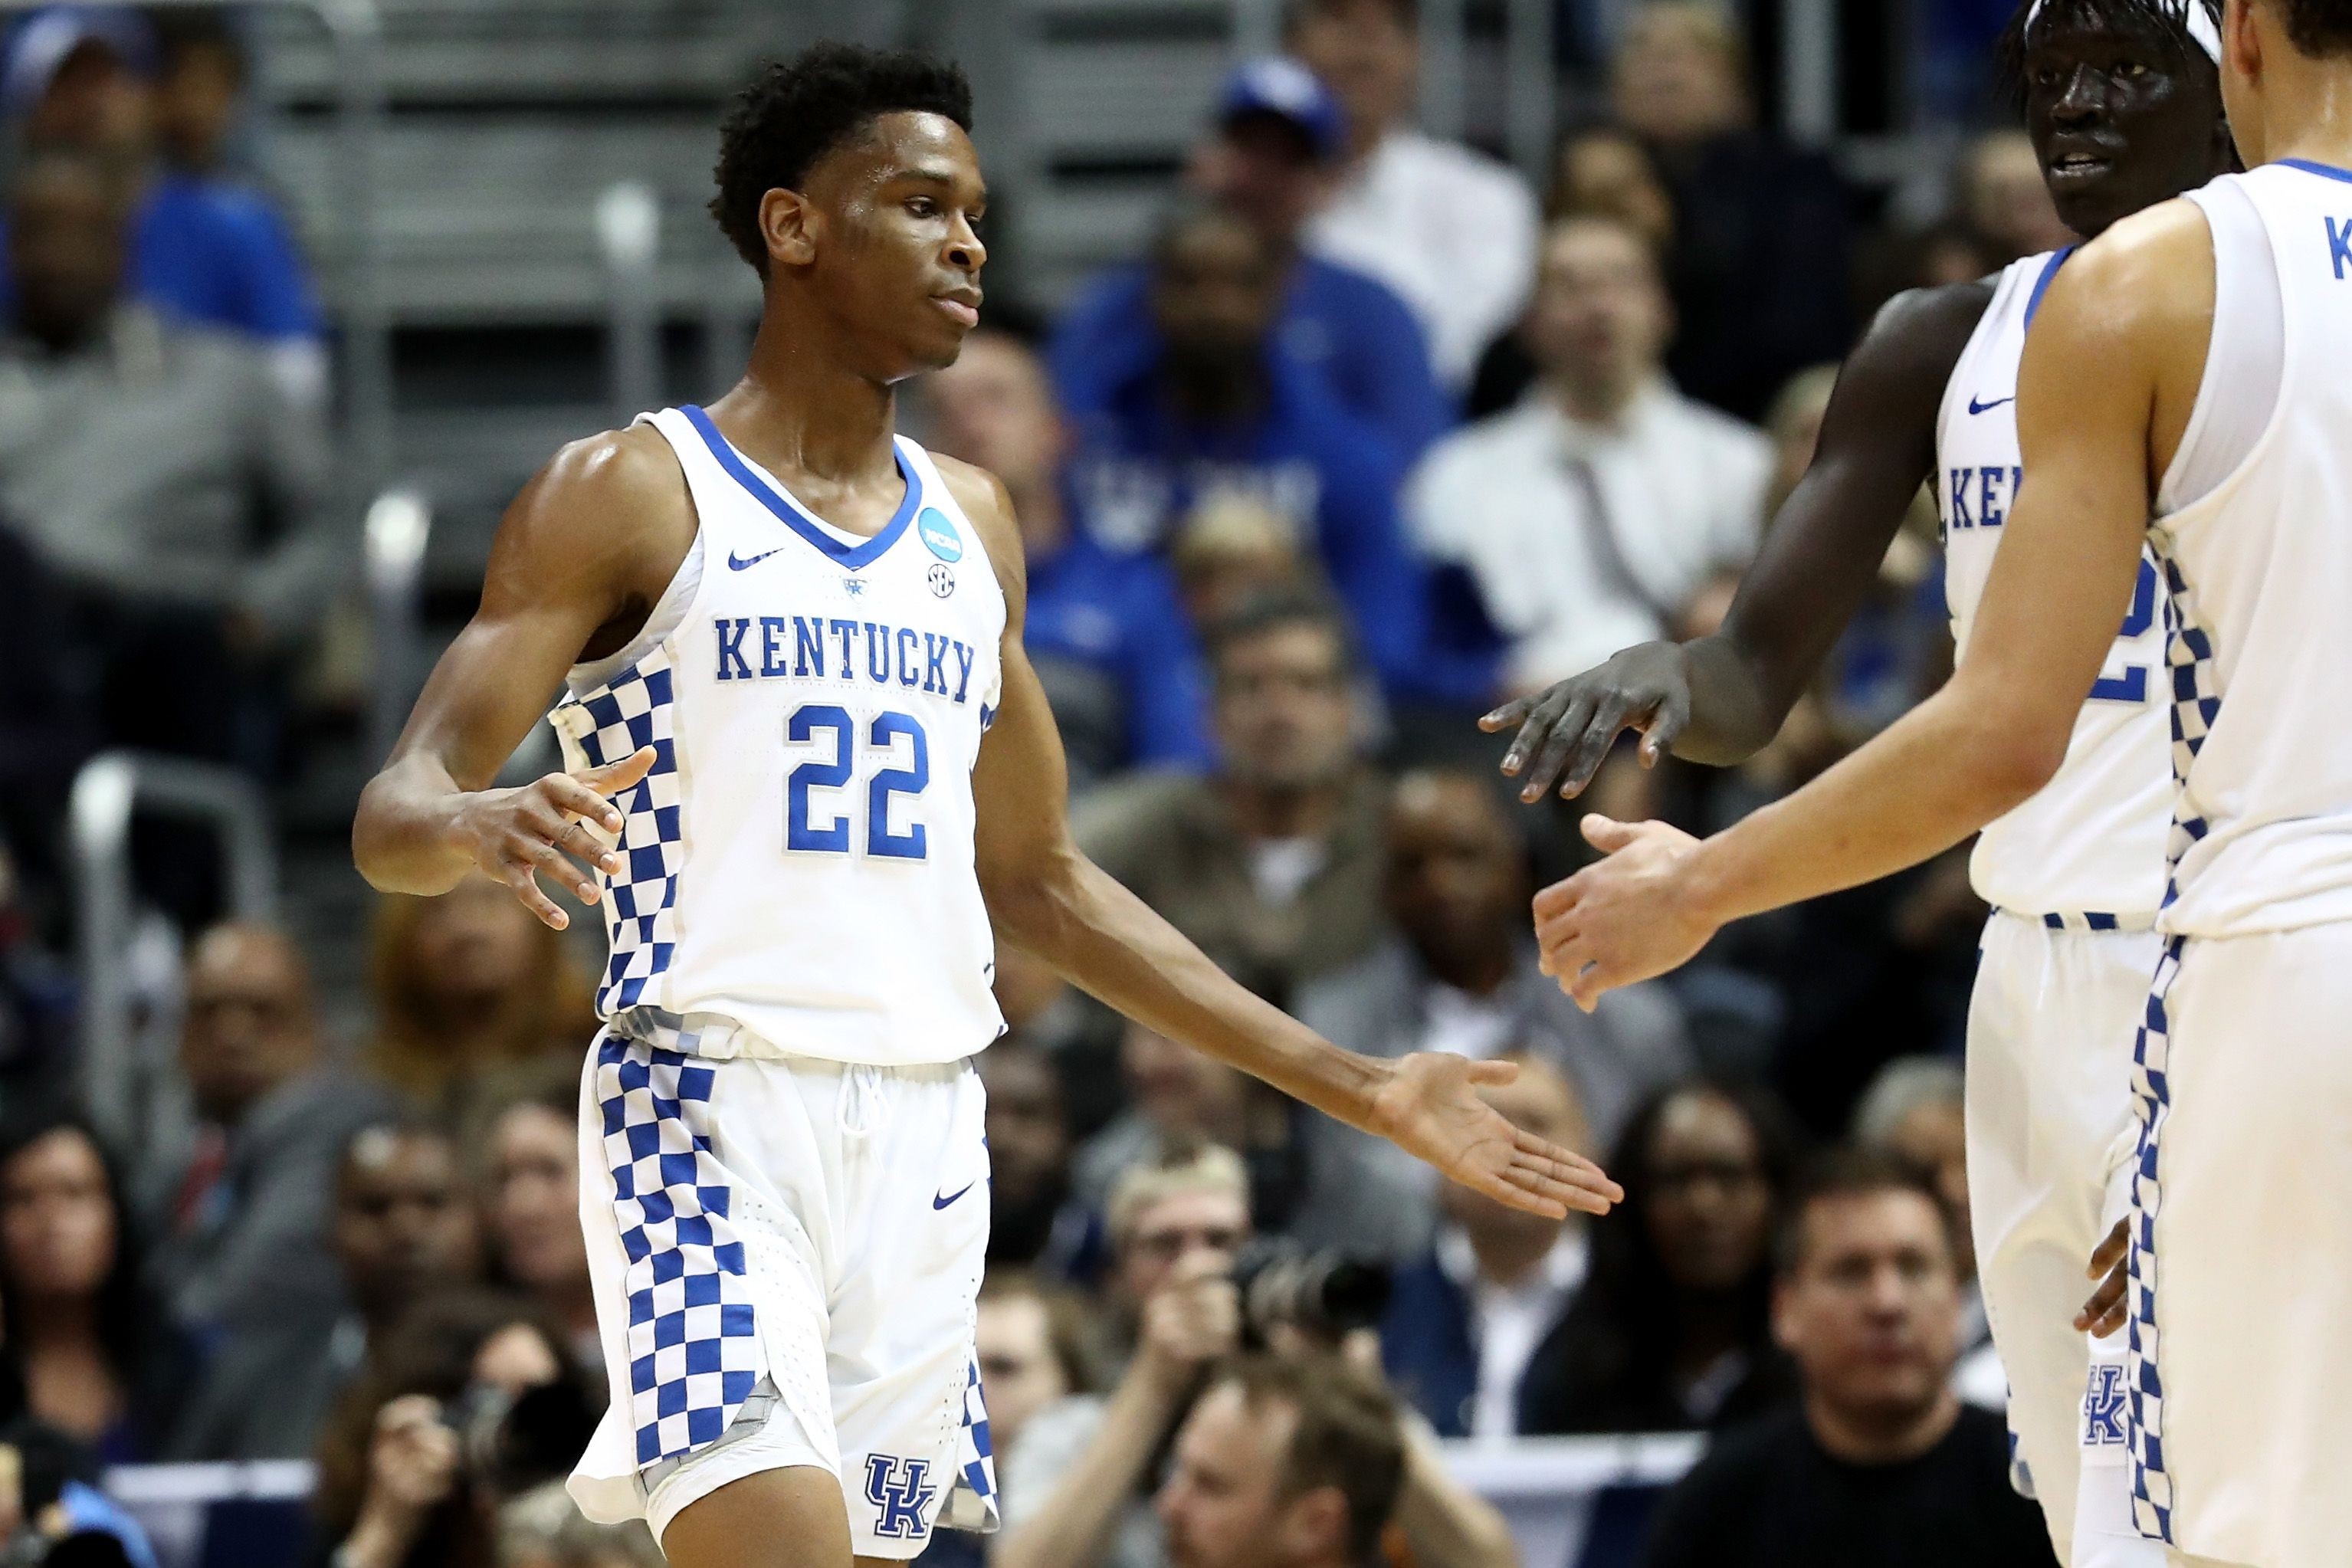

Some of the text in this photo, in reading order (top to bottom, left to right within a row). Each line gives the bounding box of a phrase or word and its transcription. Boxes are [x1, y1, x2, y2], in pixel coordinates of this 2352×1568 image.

[928, 564, 955, 598] SEC
[713, 615, 975, 704] KENTUCKY
[785, 704, 930, 860] 22
[864, 1453, 937, 1539] UK
